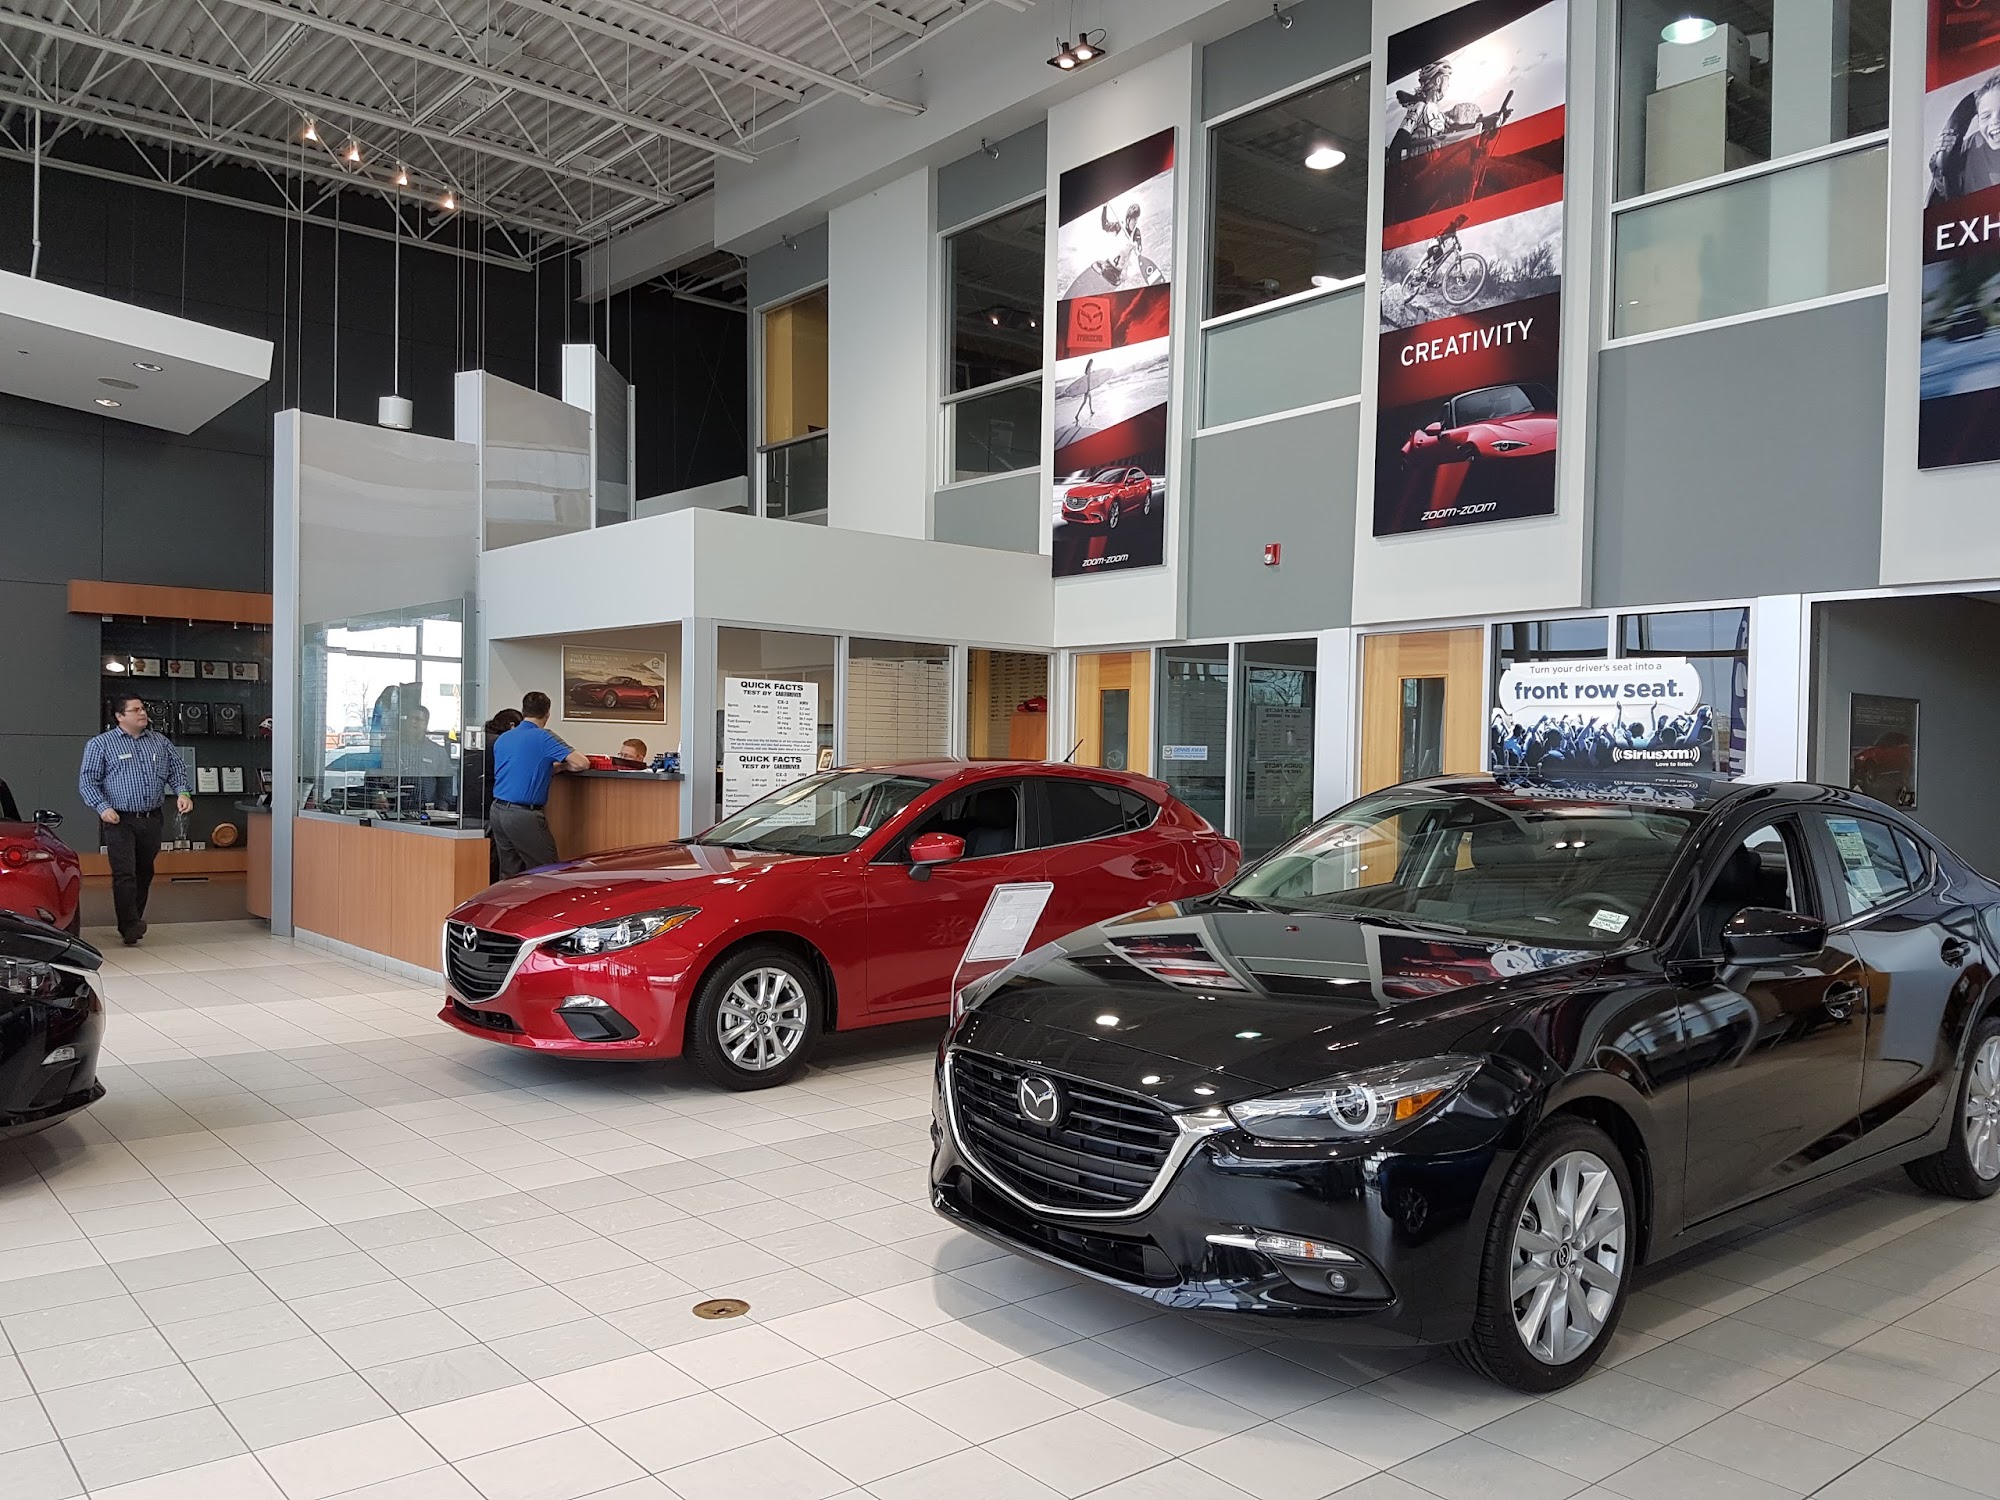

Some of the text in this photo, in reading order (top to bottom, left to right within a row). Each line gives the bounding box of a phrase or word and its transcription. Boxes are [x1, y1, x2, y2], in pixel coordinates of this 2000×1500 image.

[1400, 317, 1534, 367] CREATIVITY
[1421, 501, 1497, 521] zoom-zoom
[1082, 553, 1129, 567] zoom-zoom
[1530, 661, 1662, 675] Turn your driver's seat into a
[740, 681, 804, 692] QUICK FACTS
[1514, 679, 1684, 699] front row seat.
[739, 755, 771, 763] QUICK
